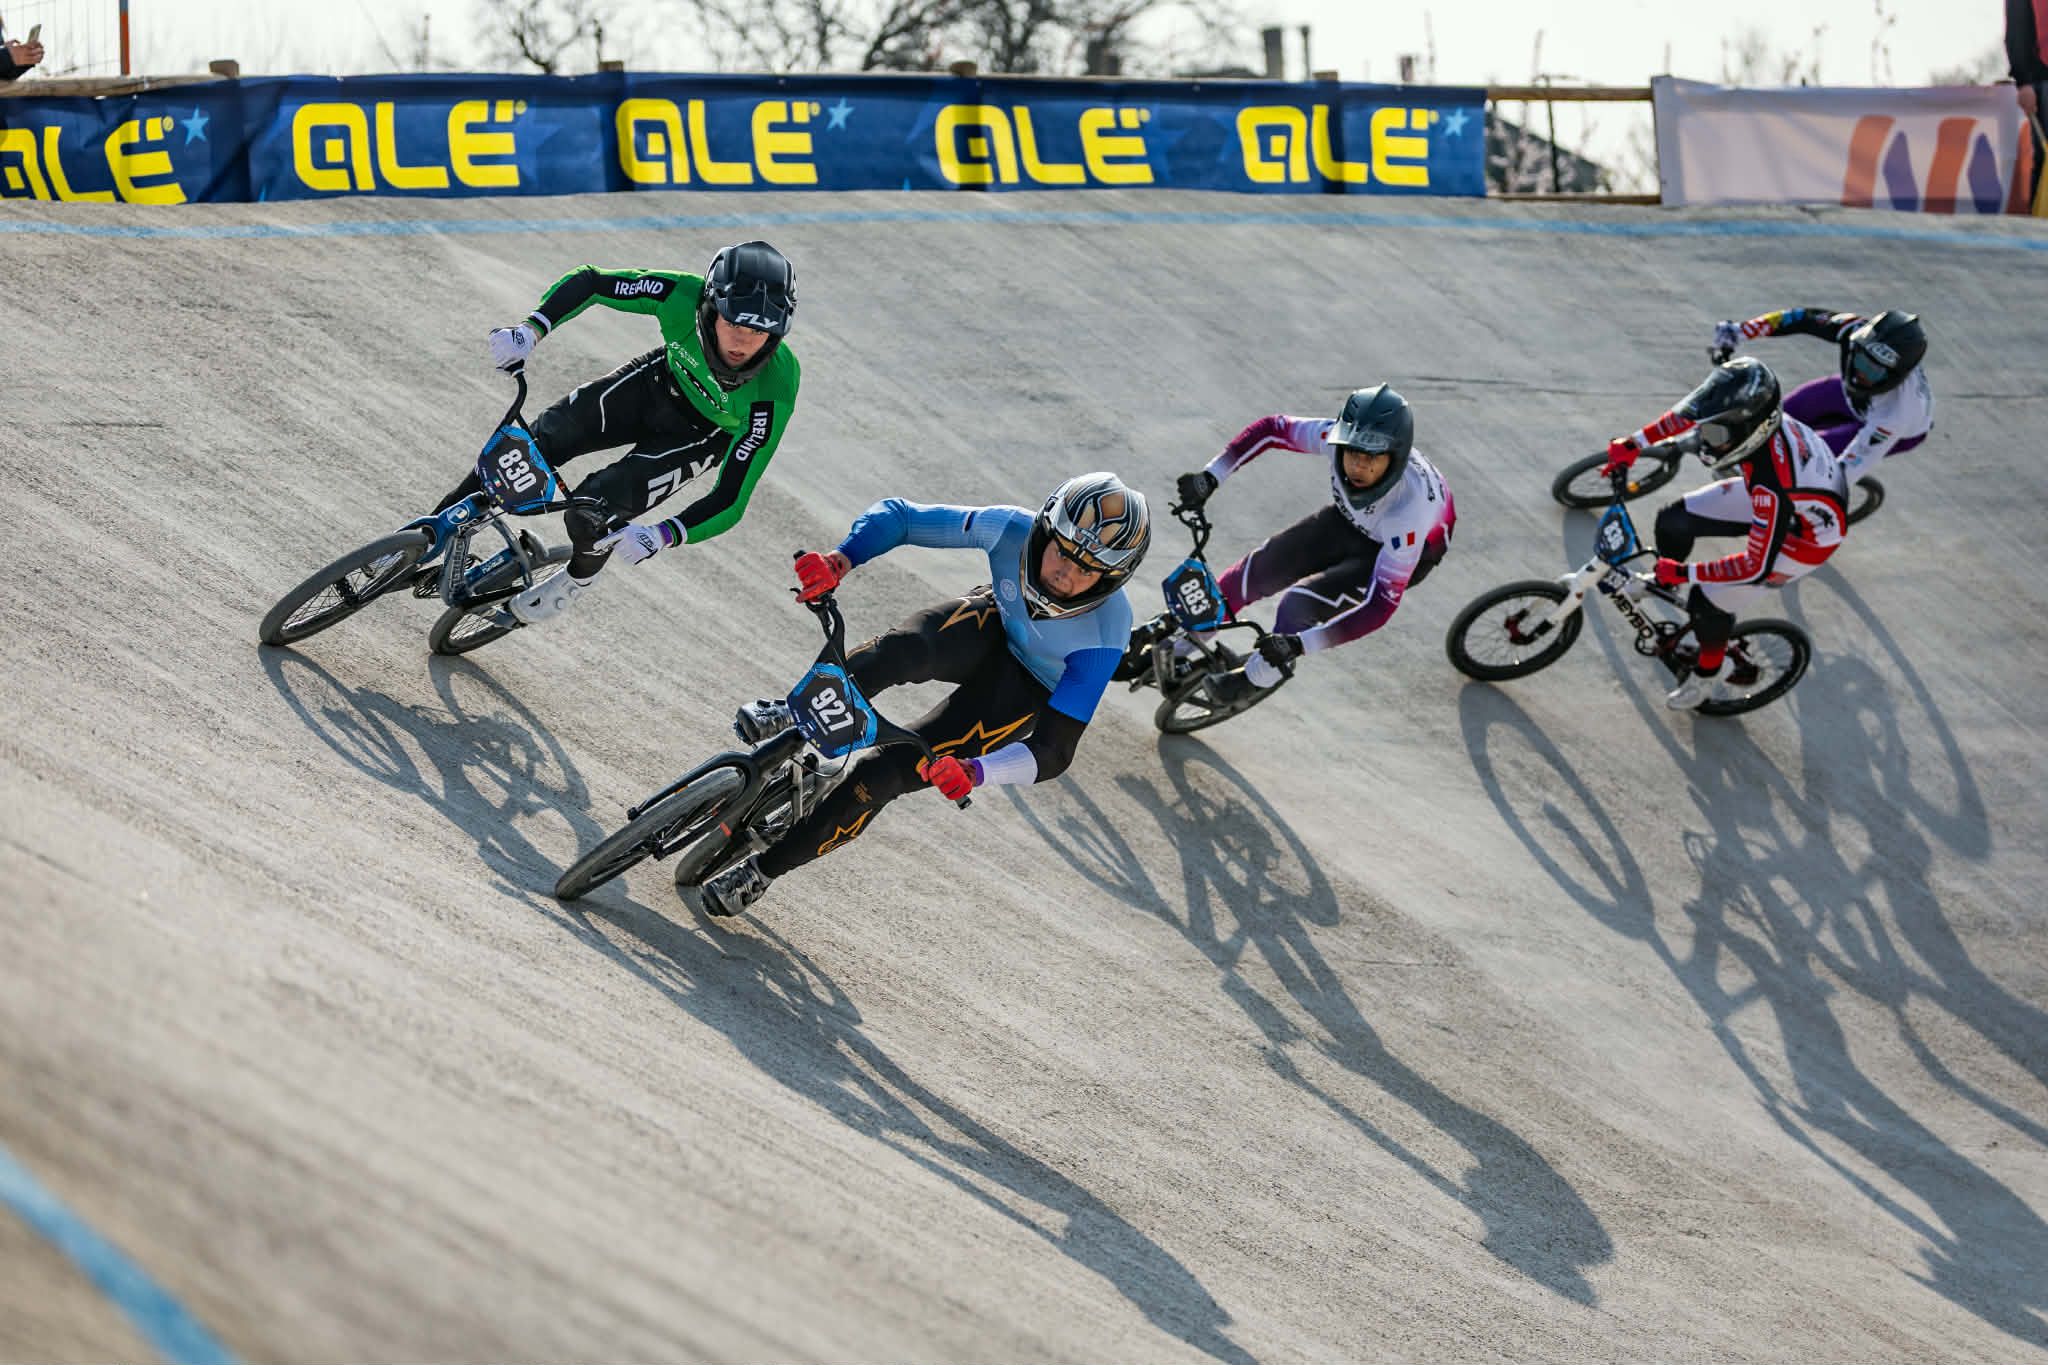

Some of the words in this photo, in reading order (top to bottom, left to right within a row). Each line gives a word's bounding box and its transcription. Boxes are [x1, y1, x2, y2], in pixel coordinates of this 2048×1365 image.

[735, 312, 779, 328] FLY
[498, 448, 537, 493] 830
[646, 453, 715, 508] FLY
[811, 687, 855, 732] 927
